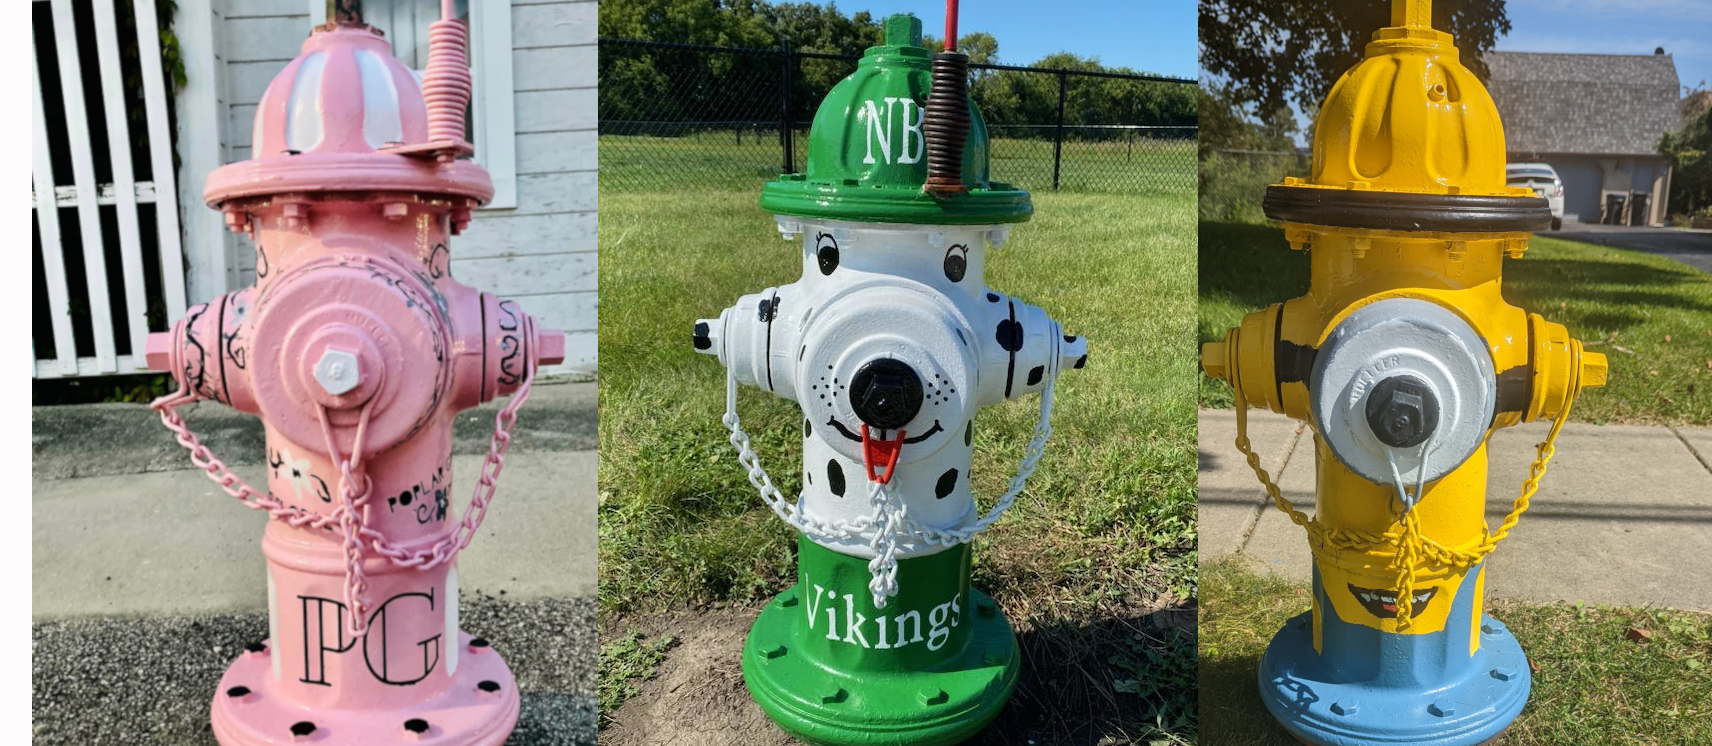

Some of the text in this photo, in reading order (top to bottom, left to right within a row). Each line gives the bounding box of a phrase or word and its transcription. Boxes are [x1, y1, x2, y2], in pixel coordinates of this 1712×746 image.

[387, 467, 445, 513] POPLAR
[297, 587, 442, 687] PG
[805, 572, 961, 651] Vikings
